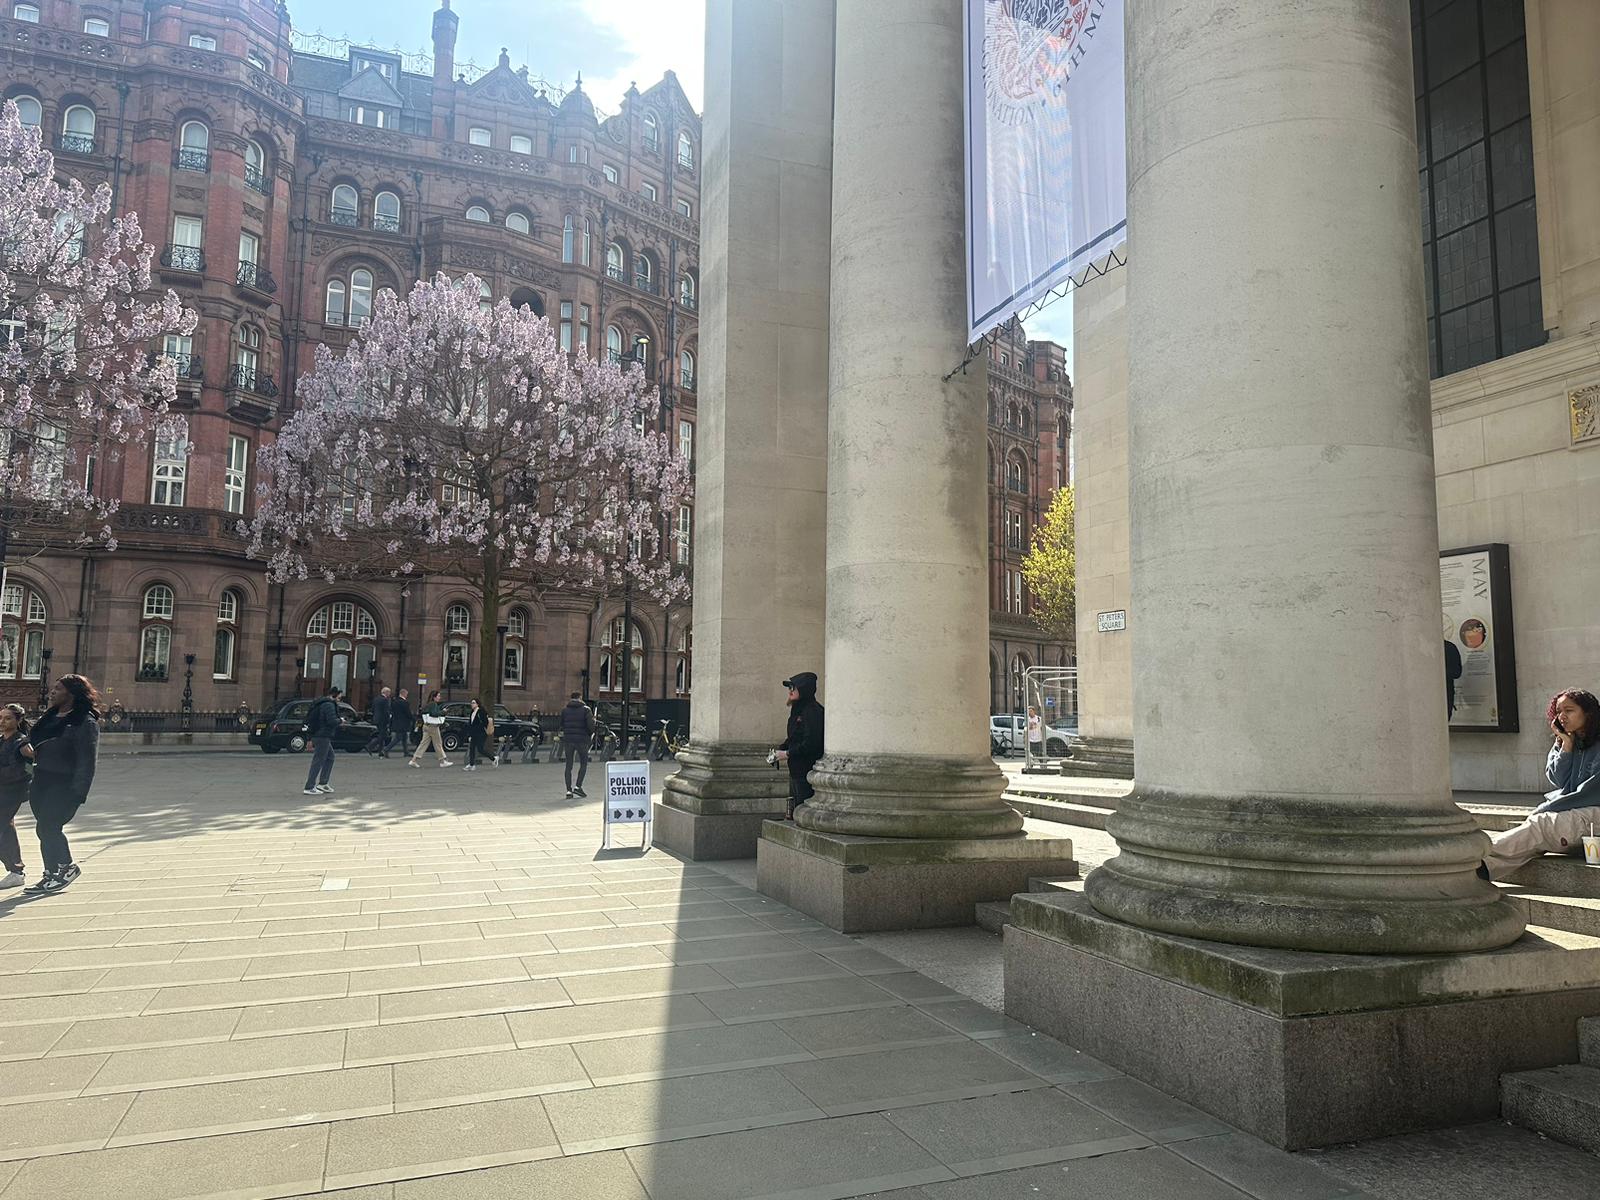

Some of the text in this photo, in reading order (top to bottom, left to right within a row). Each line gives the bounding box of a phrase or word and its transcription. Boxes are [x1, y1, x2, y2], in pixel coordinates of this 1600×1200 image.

[1472, 558, 1488, 600] MAY
[1102, 622, 1122, 630] SQUARE
[610, 776, 646, 786] POLLING
[611, 786, 646, 796] STATION
